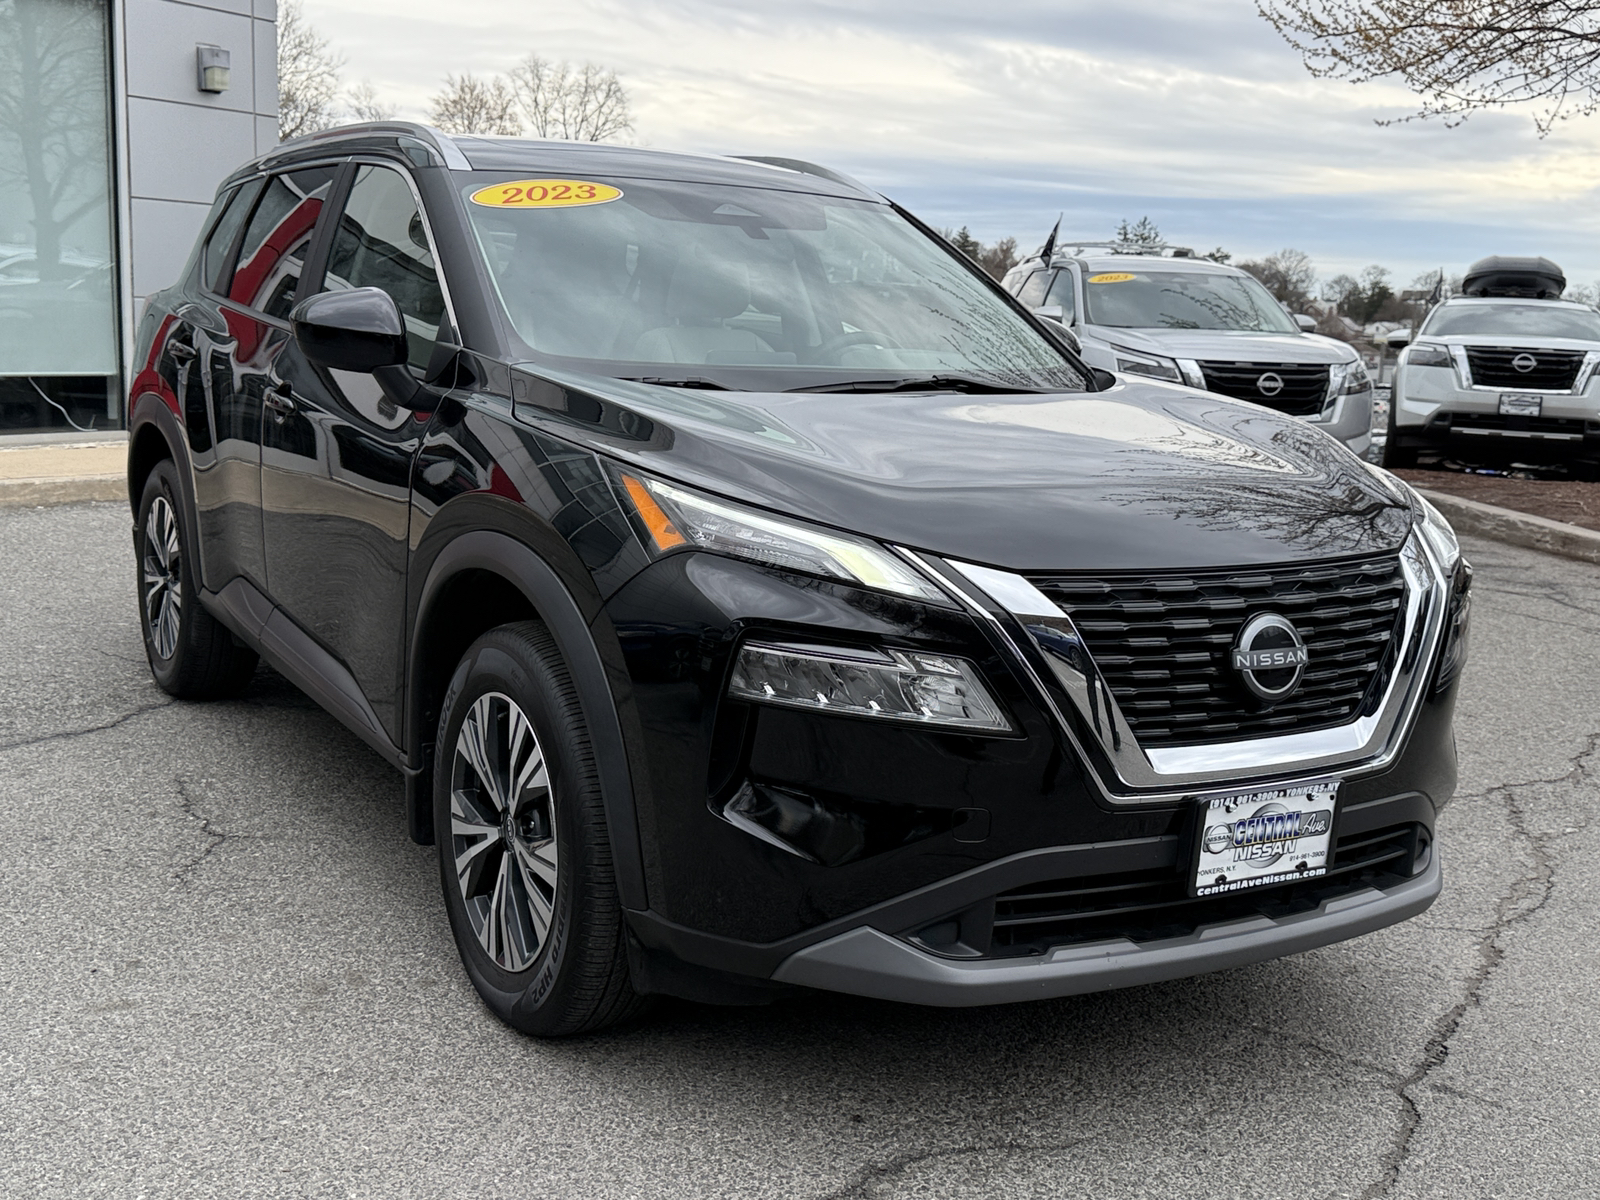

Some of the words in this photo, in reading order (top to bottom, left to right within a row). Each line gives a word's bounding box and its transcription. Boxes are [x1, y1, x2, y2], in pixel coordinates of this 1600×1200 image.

[502, 185, 597, 204] 2023
[1098, 274, 1129, 282] 2023
[1236, 649, 1307, 667] NISSAN
[1233, 811, 1302, 847] CENTRAL
[1302, 813, 1326, 834] Ave.
[1207, 834, 1231, 843] NISSAN
[1233, 839, 1298, 862] NISSAN
